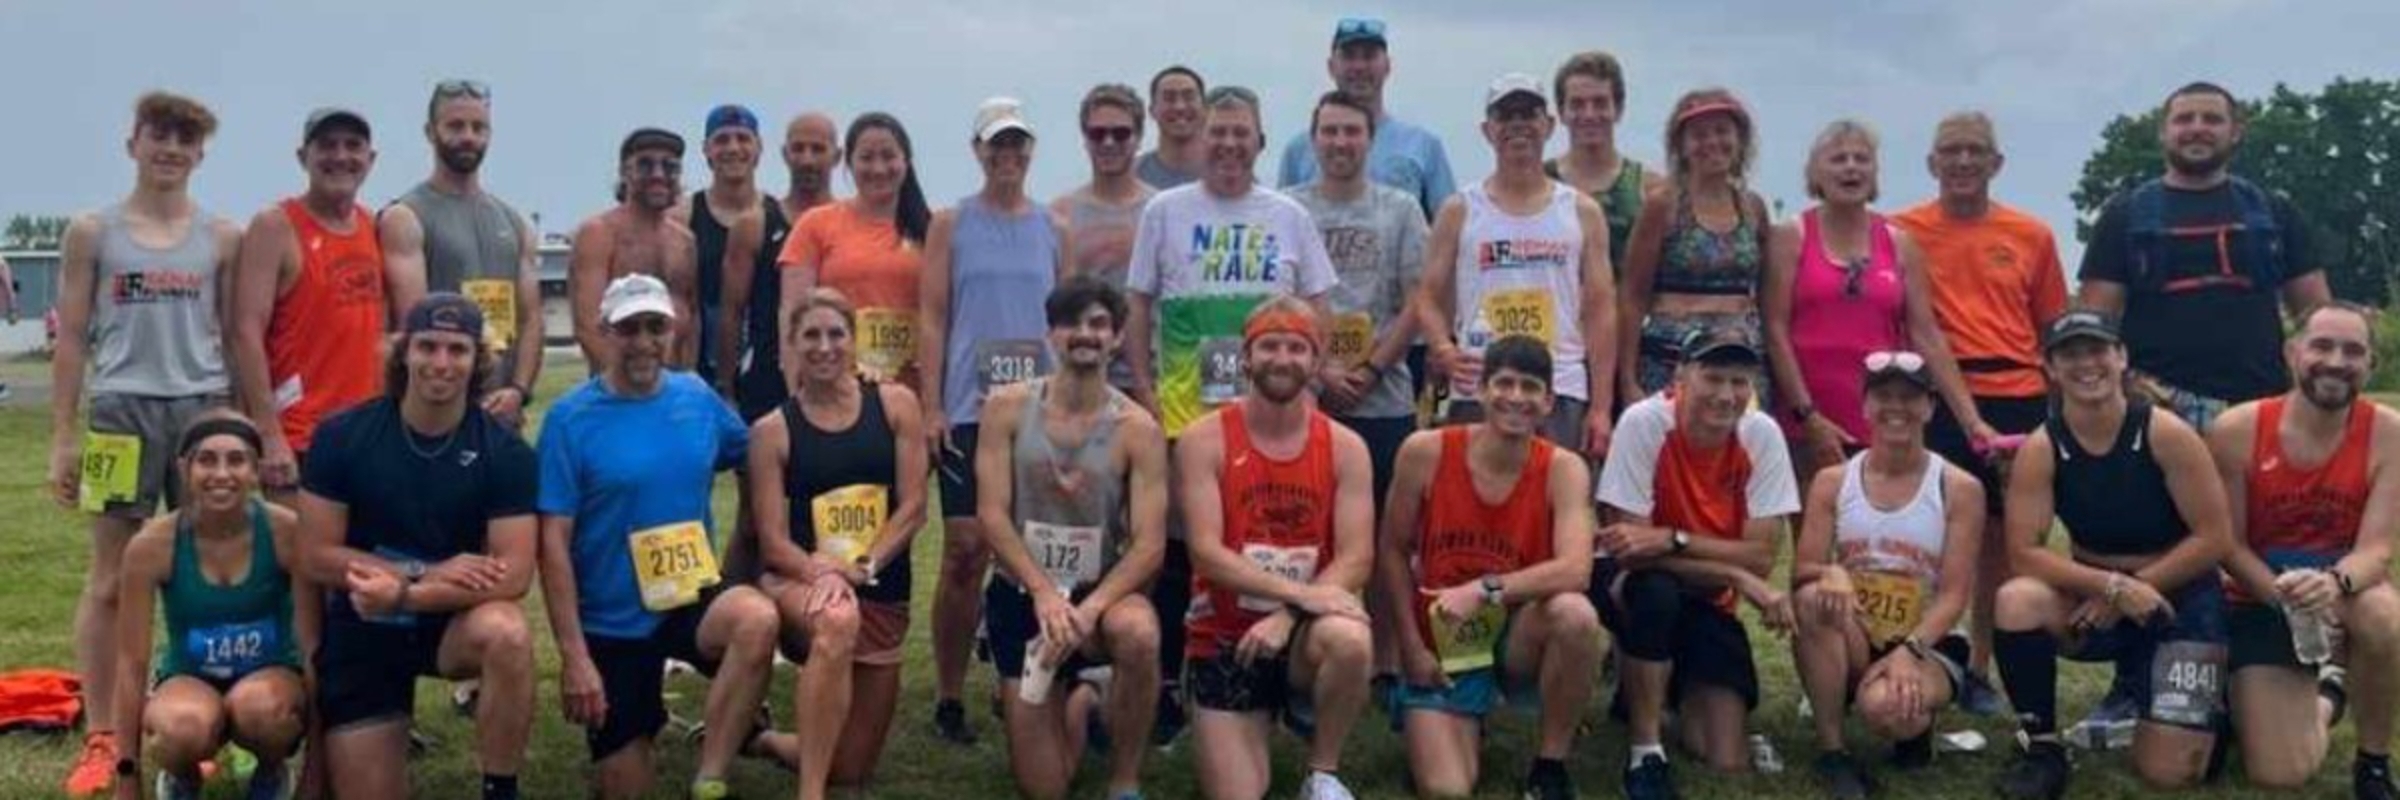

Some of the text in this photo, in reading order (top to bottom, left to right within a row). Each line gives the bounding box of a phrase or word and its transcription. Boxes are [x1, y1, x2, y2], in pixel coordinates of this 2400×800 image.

[1494, 306, 1543, 333] 3025
[826, 503, 877, 534] 3004
[649, 542, 704, 577] 2751
[1044, 544, 1081, 572] 172
[1854, 588, 1911, 625] 2215
[203, 629, 262, 663] 1442
[2167, 661, 2217, 692] 4841
